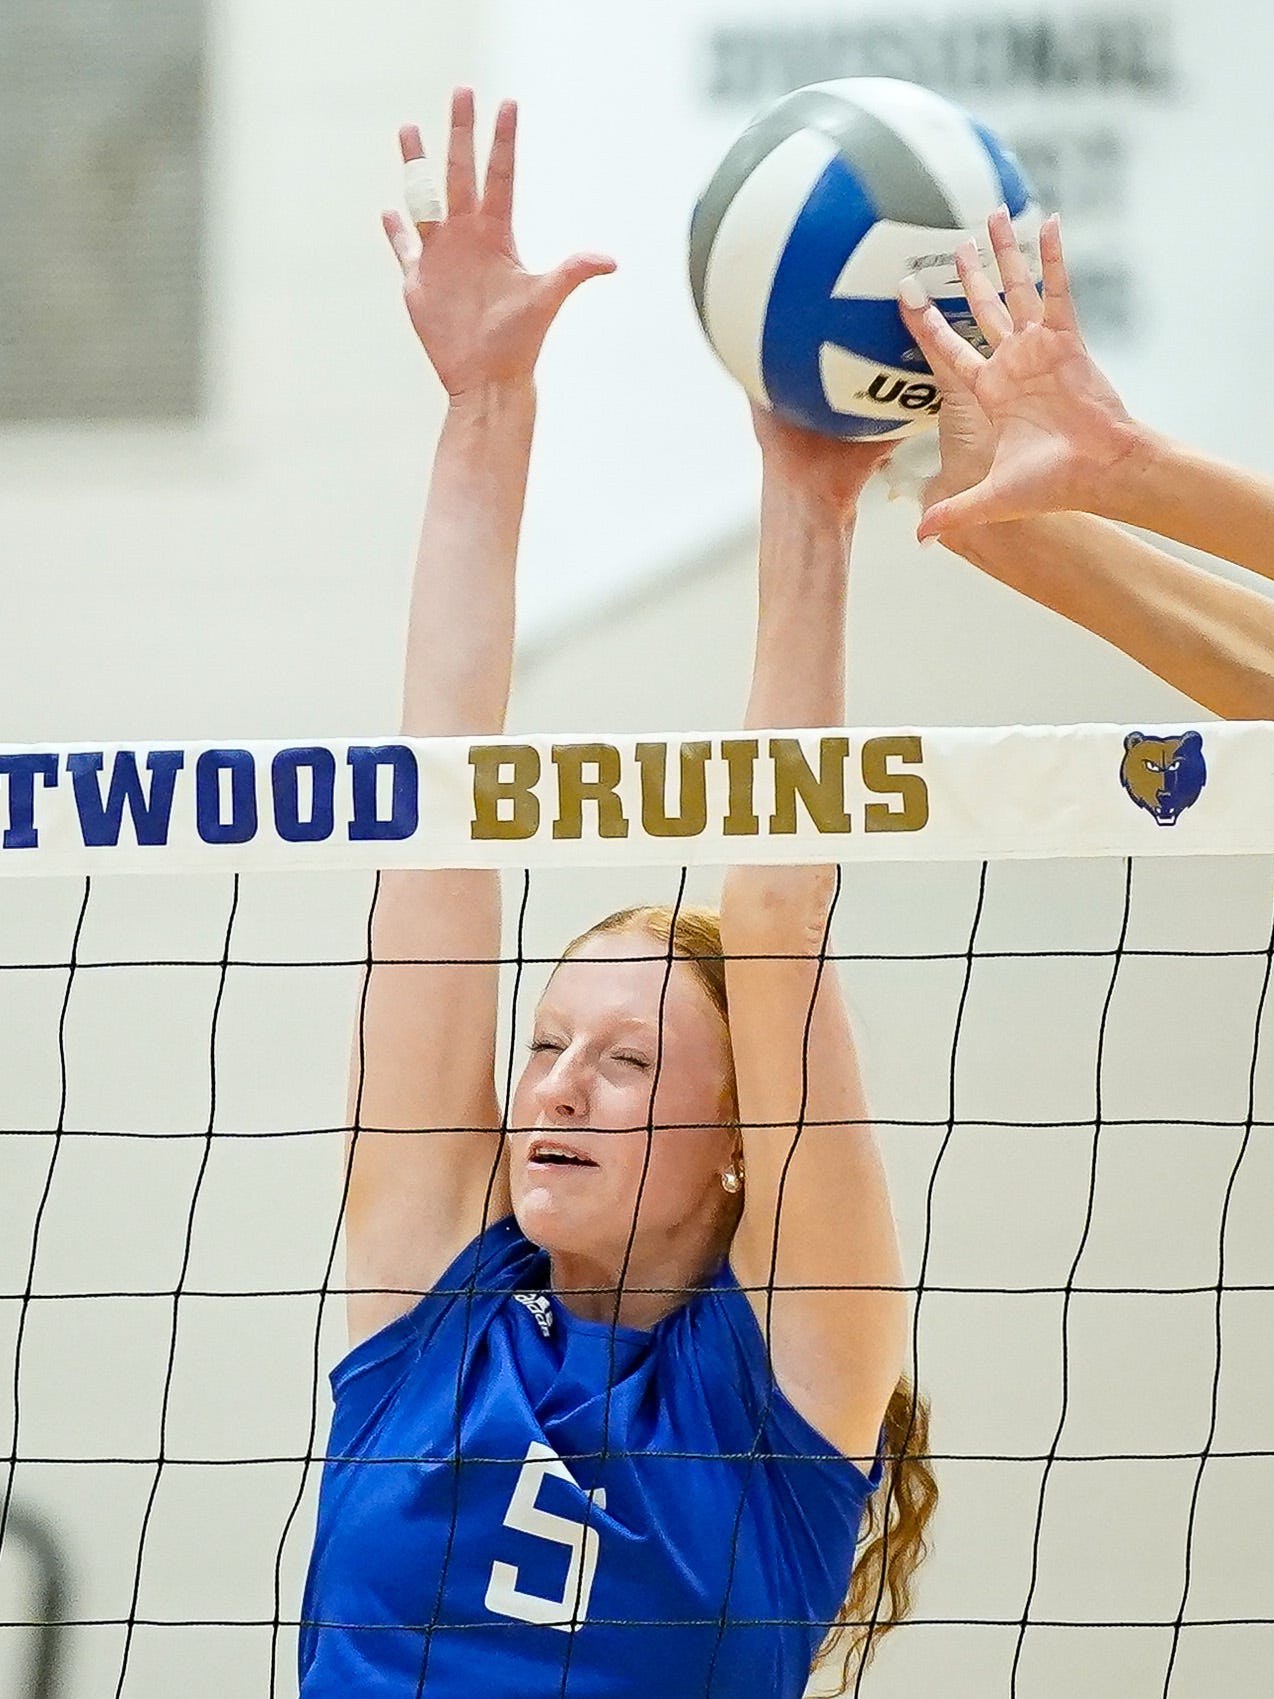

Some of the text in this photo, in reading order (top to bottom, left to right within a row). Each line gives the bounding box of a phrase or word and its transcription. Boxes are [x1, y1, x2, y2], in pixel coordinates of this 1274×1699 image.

[866, 371, 943, 415] en
[0, 744, 419, 849] TWOOD
[468, 735, 930, 841] BRUINS
[484, 1440, 606, 1633] 5
